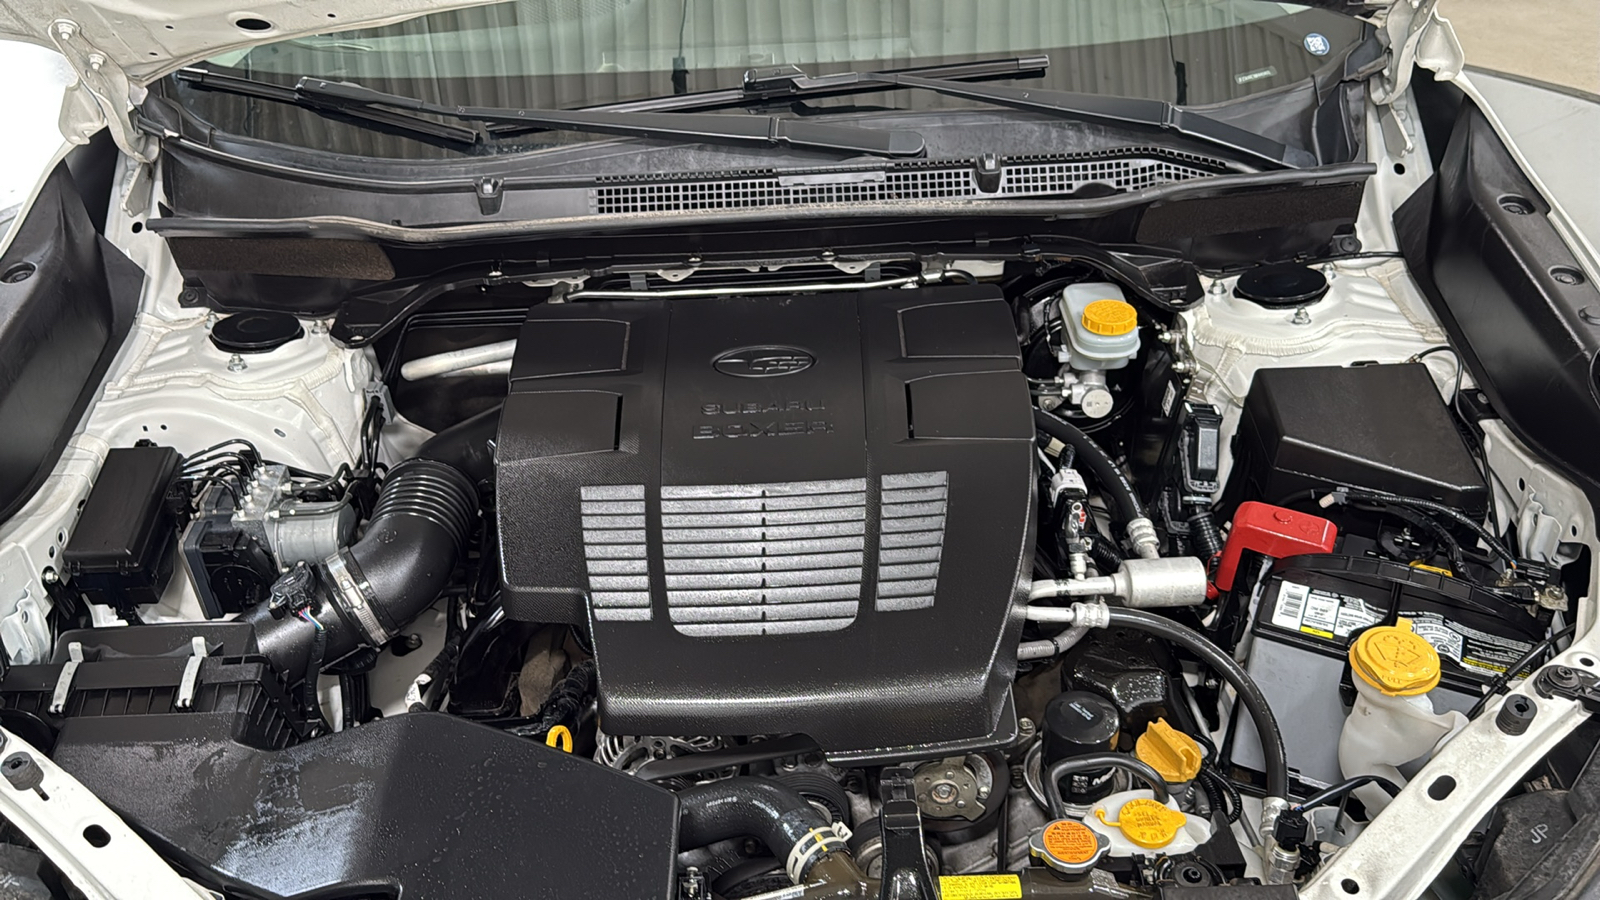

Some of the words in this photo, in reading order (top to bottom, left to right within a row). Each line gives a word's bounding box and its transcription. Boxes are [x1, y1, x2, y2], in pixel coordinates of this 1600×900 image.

[701, 400, 825, 415] SUBARU
[692, 421, 835, 440] BOXER
[1531, 824, 1548, 843] JP
